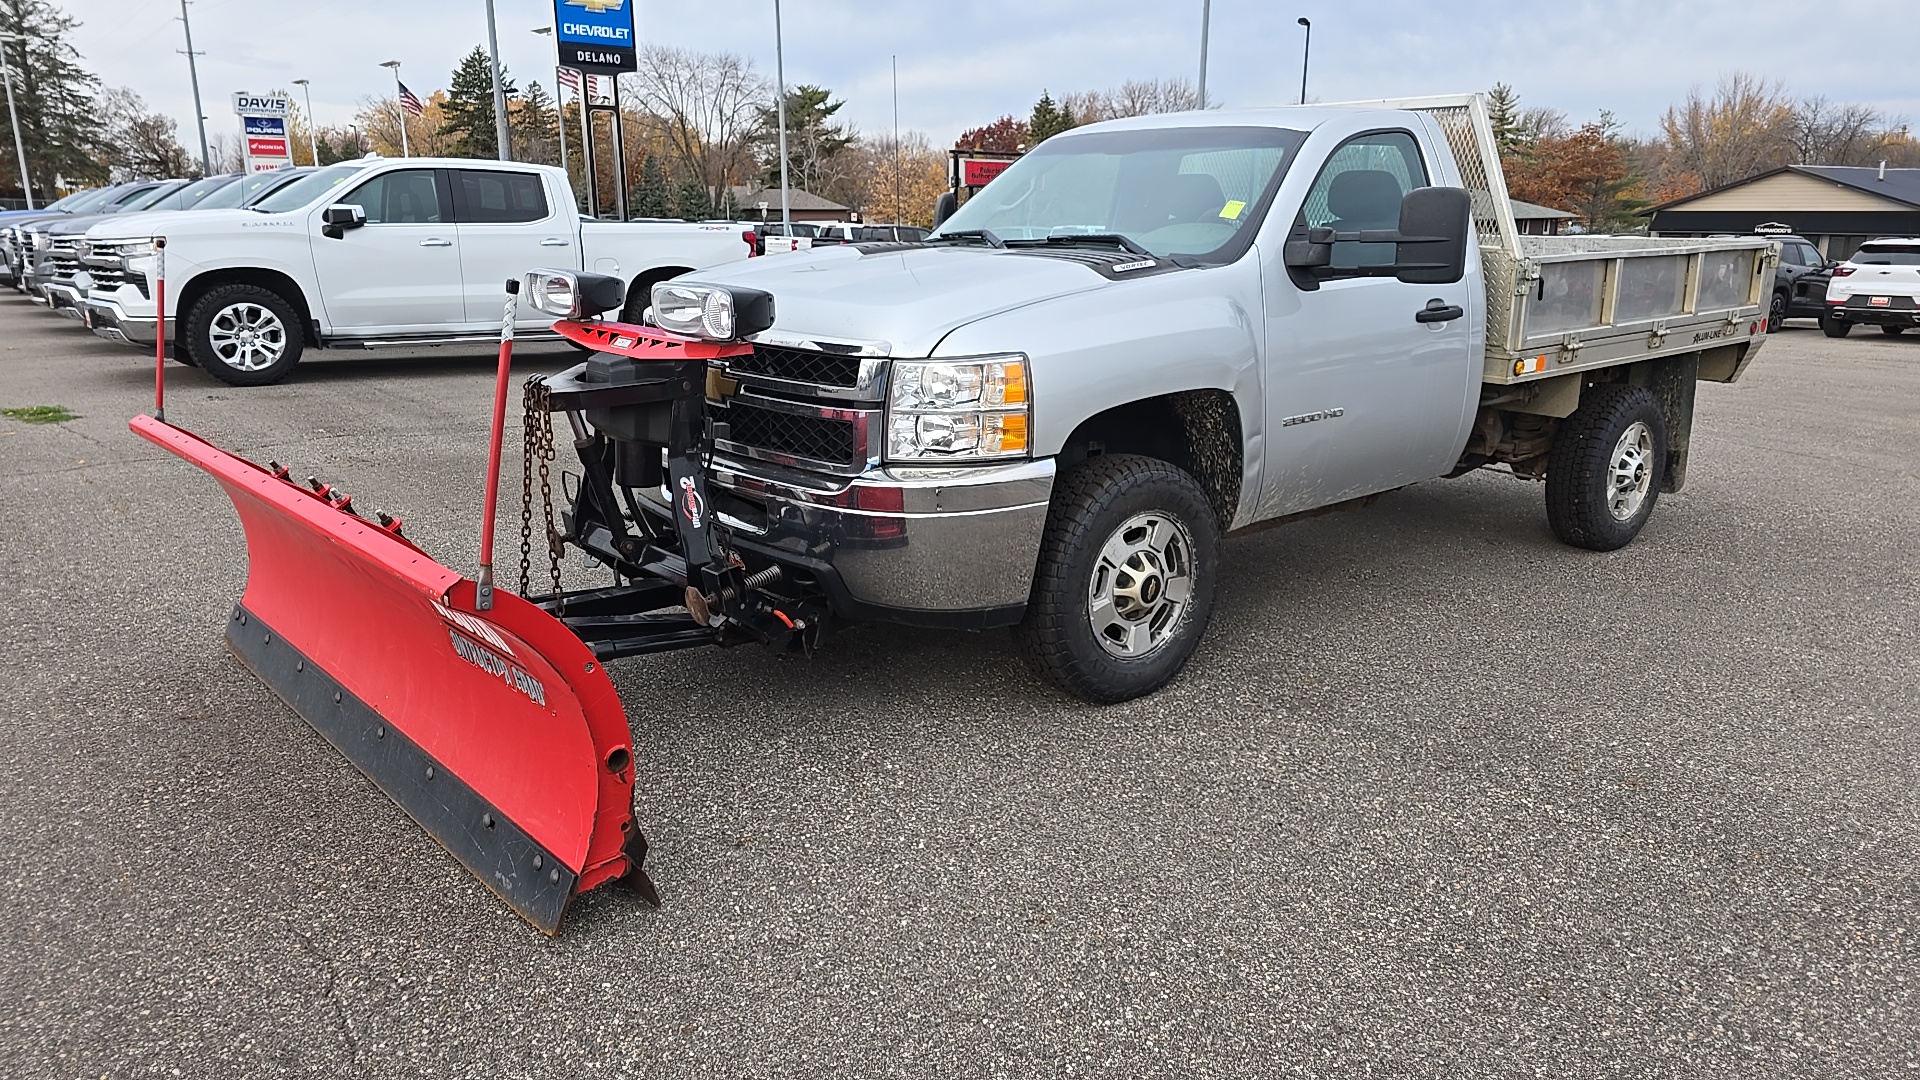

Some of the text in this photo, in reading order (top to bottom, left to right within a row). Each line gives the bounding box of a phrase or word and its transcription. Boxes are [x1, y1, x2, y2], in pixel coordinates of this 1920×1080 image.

[563, 22, 630, 40] CHEVROLET
[576, 50, 621, 65] DELANO
[238, 97, 286, 109] DAVIS
[246, 126, 283, 134] POLARIS
[258, 143, 285, 151] HONDA
[1282, 407, 1344, 428] 2500 HD
